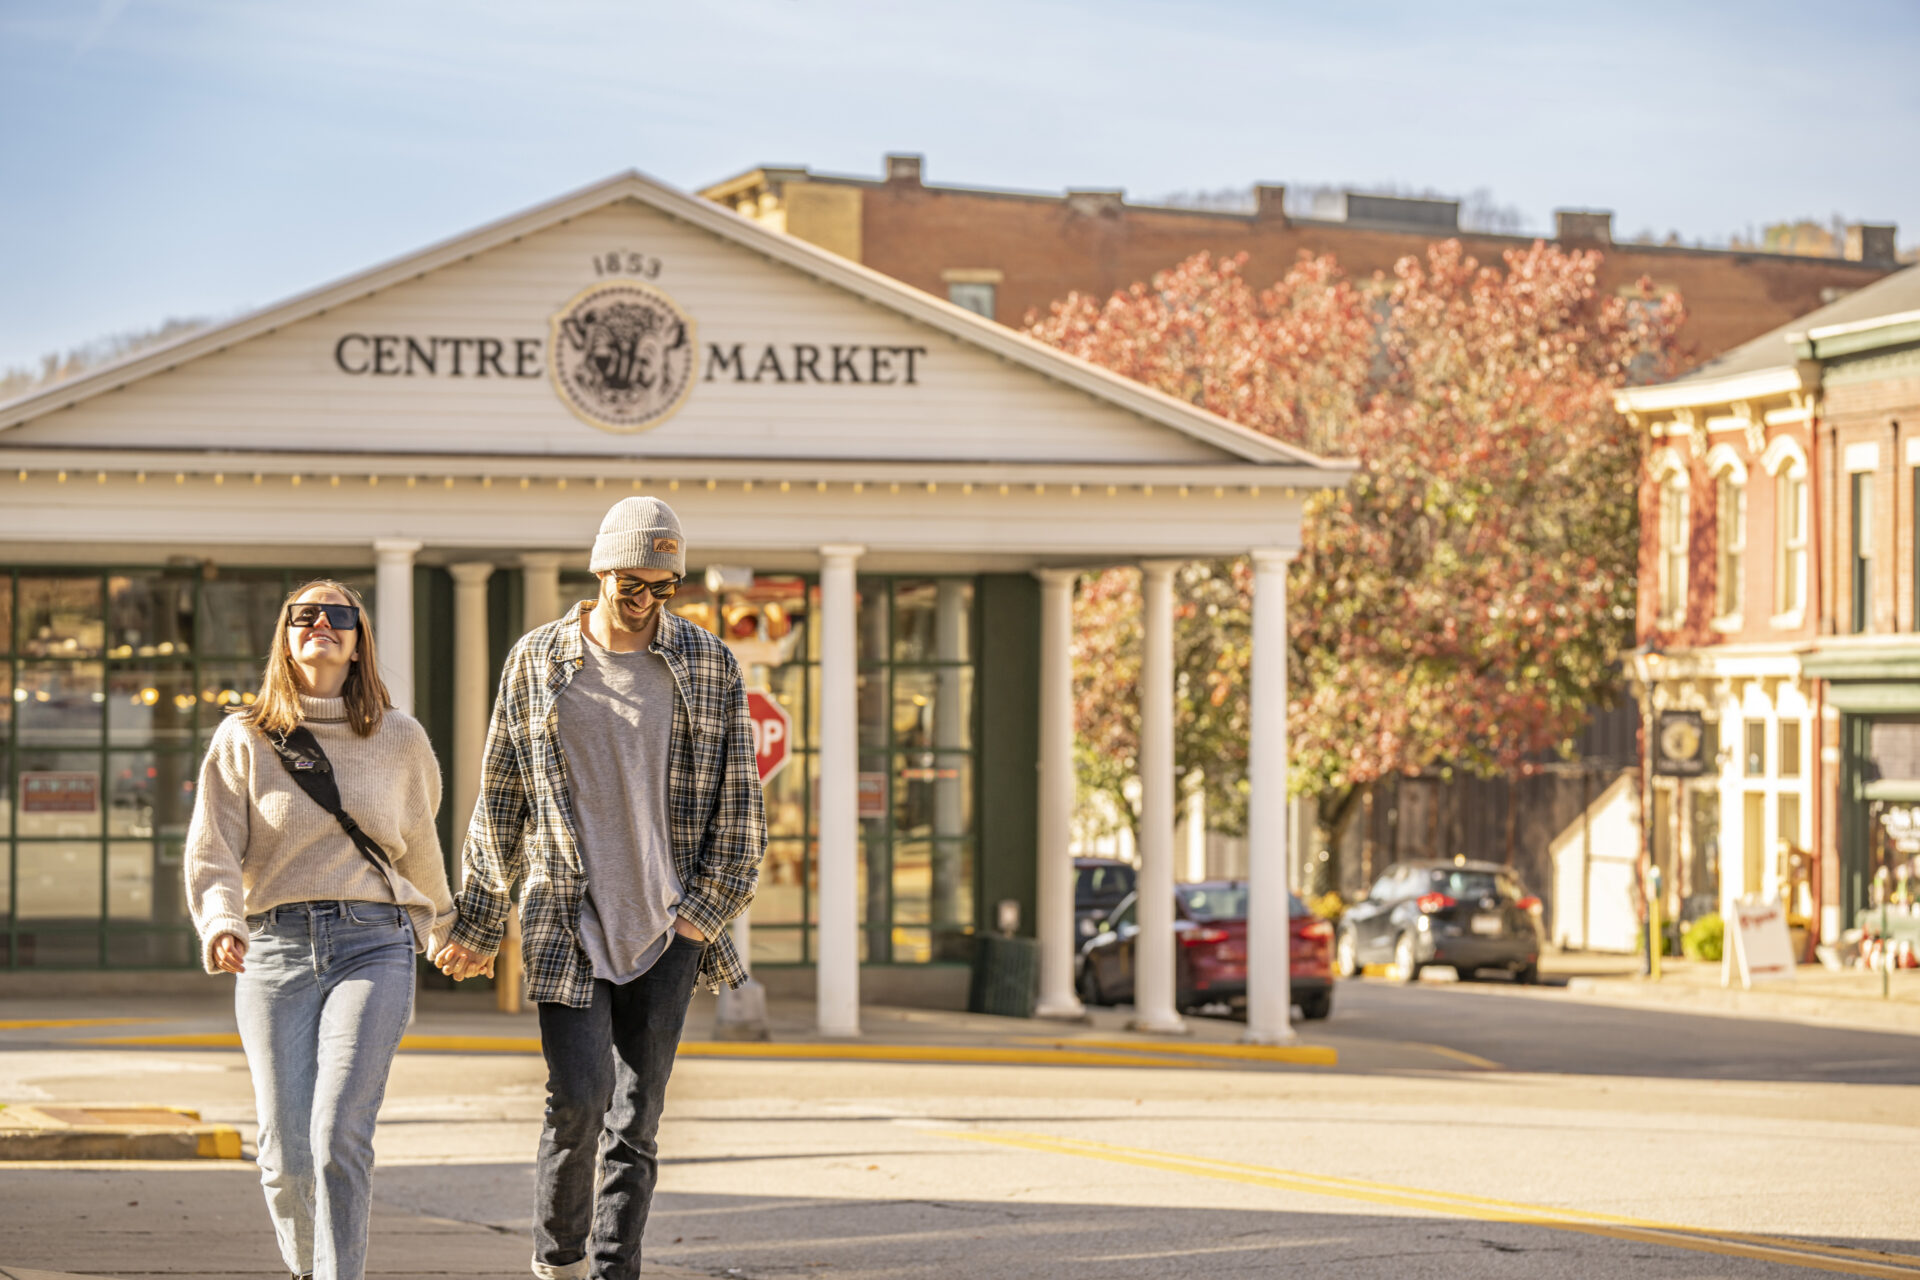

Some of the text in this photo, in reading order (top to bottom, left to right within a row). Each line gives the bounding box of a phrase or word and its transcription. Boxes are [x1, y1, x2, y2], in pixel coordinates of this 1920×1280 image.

[593, 252, 662, 280] 1853
[334, 333, 927, 385] CENTRE MARKET
